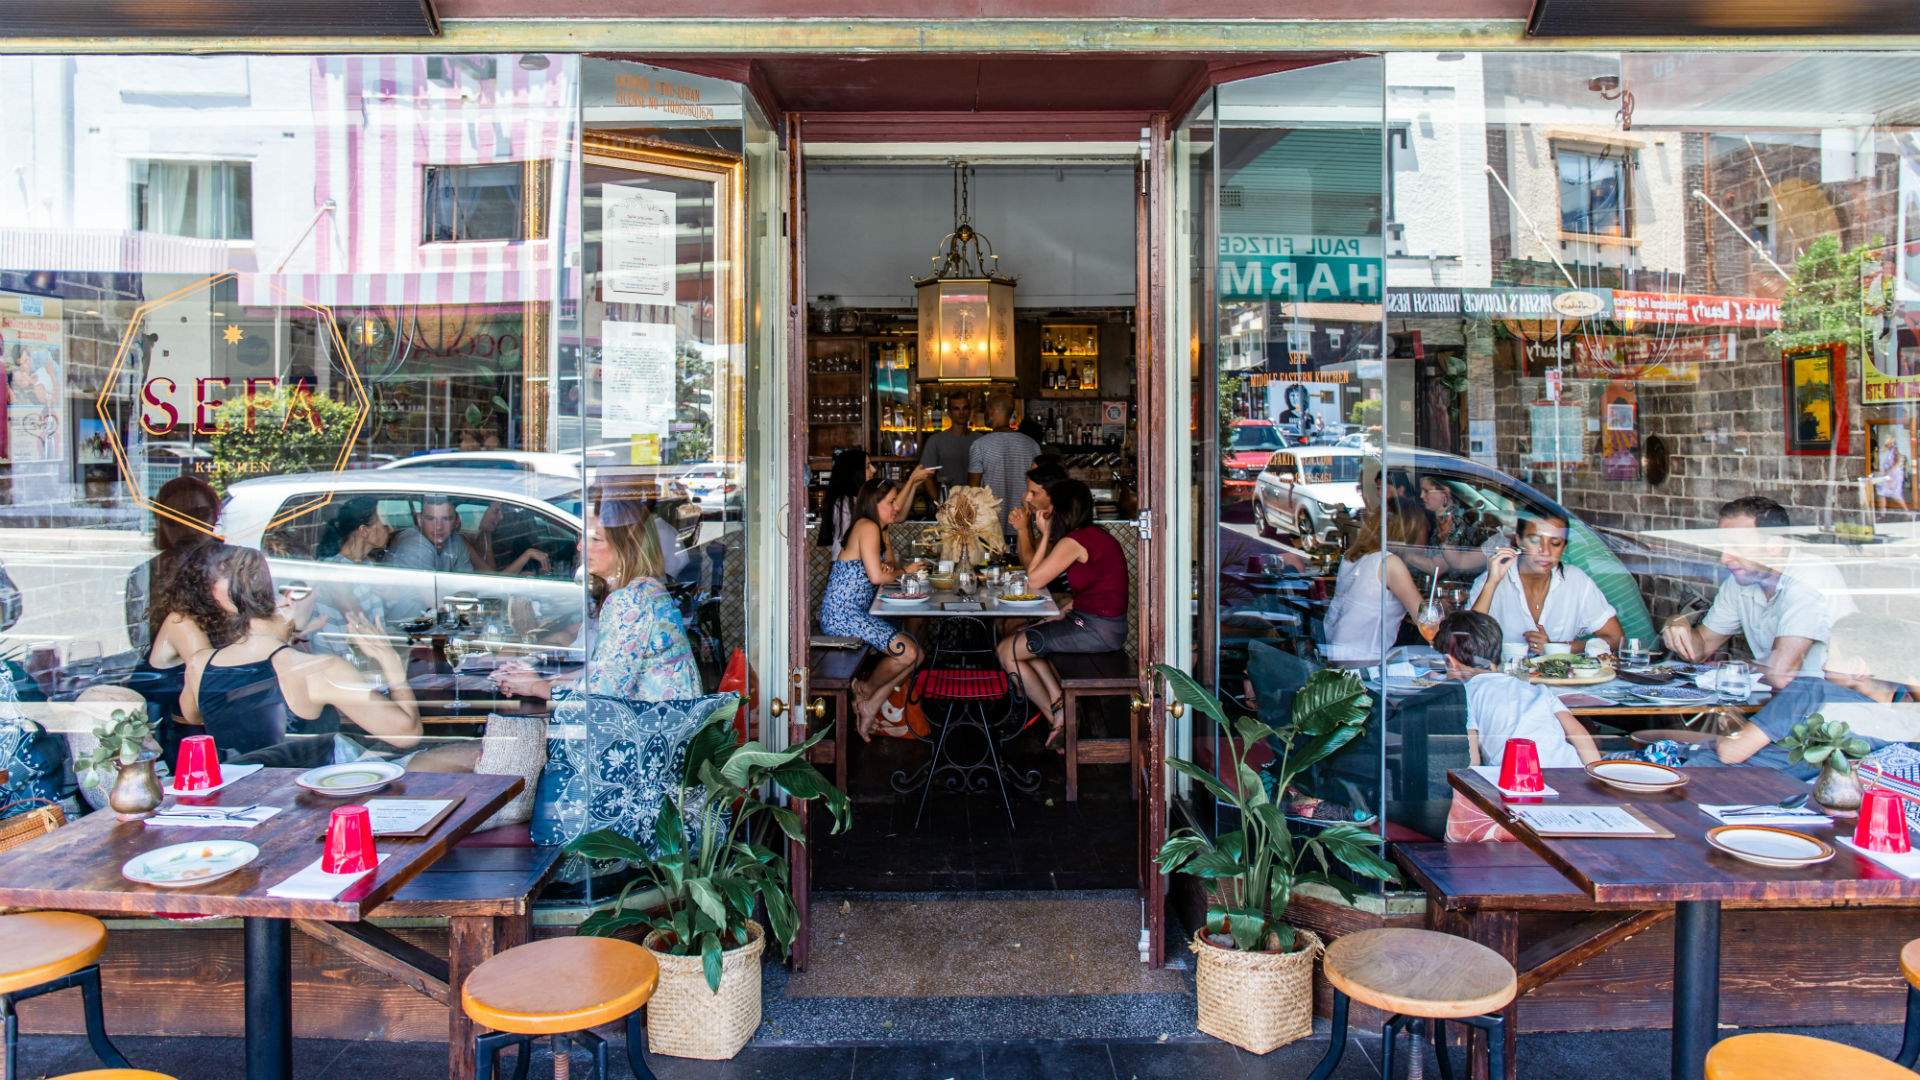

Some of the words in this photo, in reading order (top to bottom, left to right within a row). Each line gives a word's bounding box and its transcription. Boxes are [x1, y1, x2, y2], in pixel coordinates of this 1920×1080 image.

[1315, 369, 1349, 384] KITCHEN
[141, 377, 324, 436] SEFA
[195, 461, 272, 474] KITCHEN
